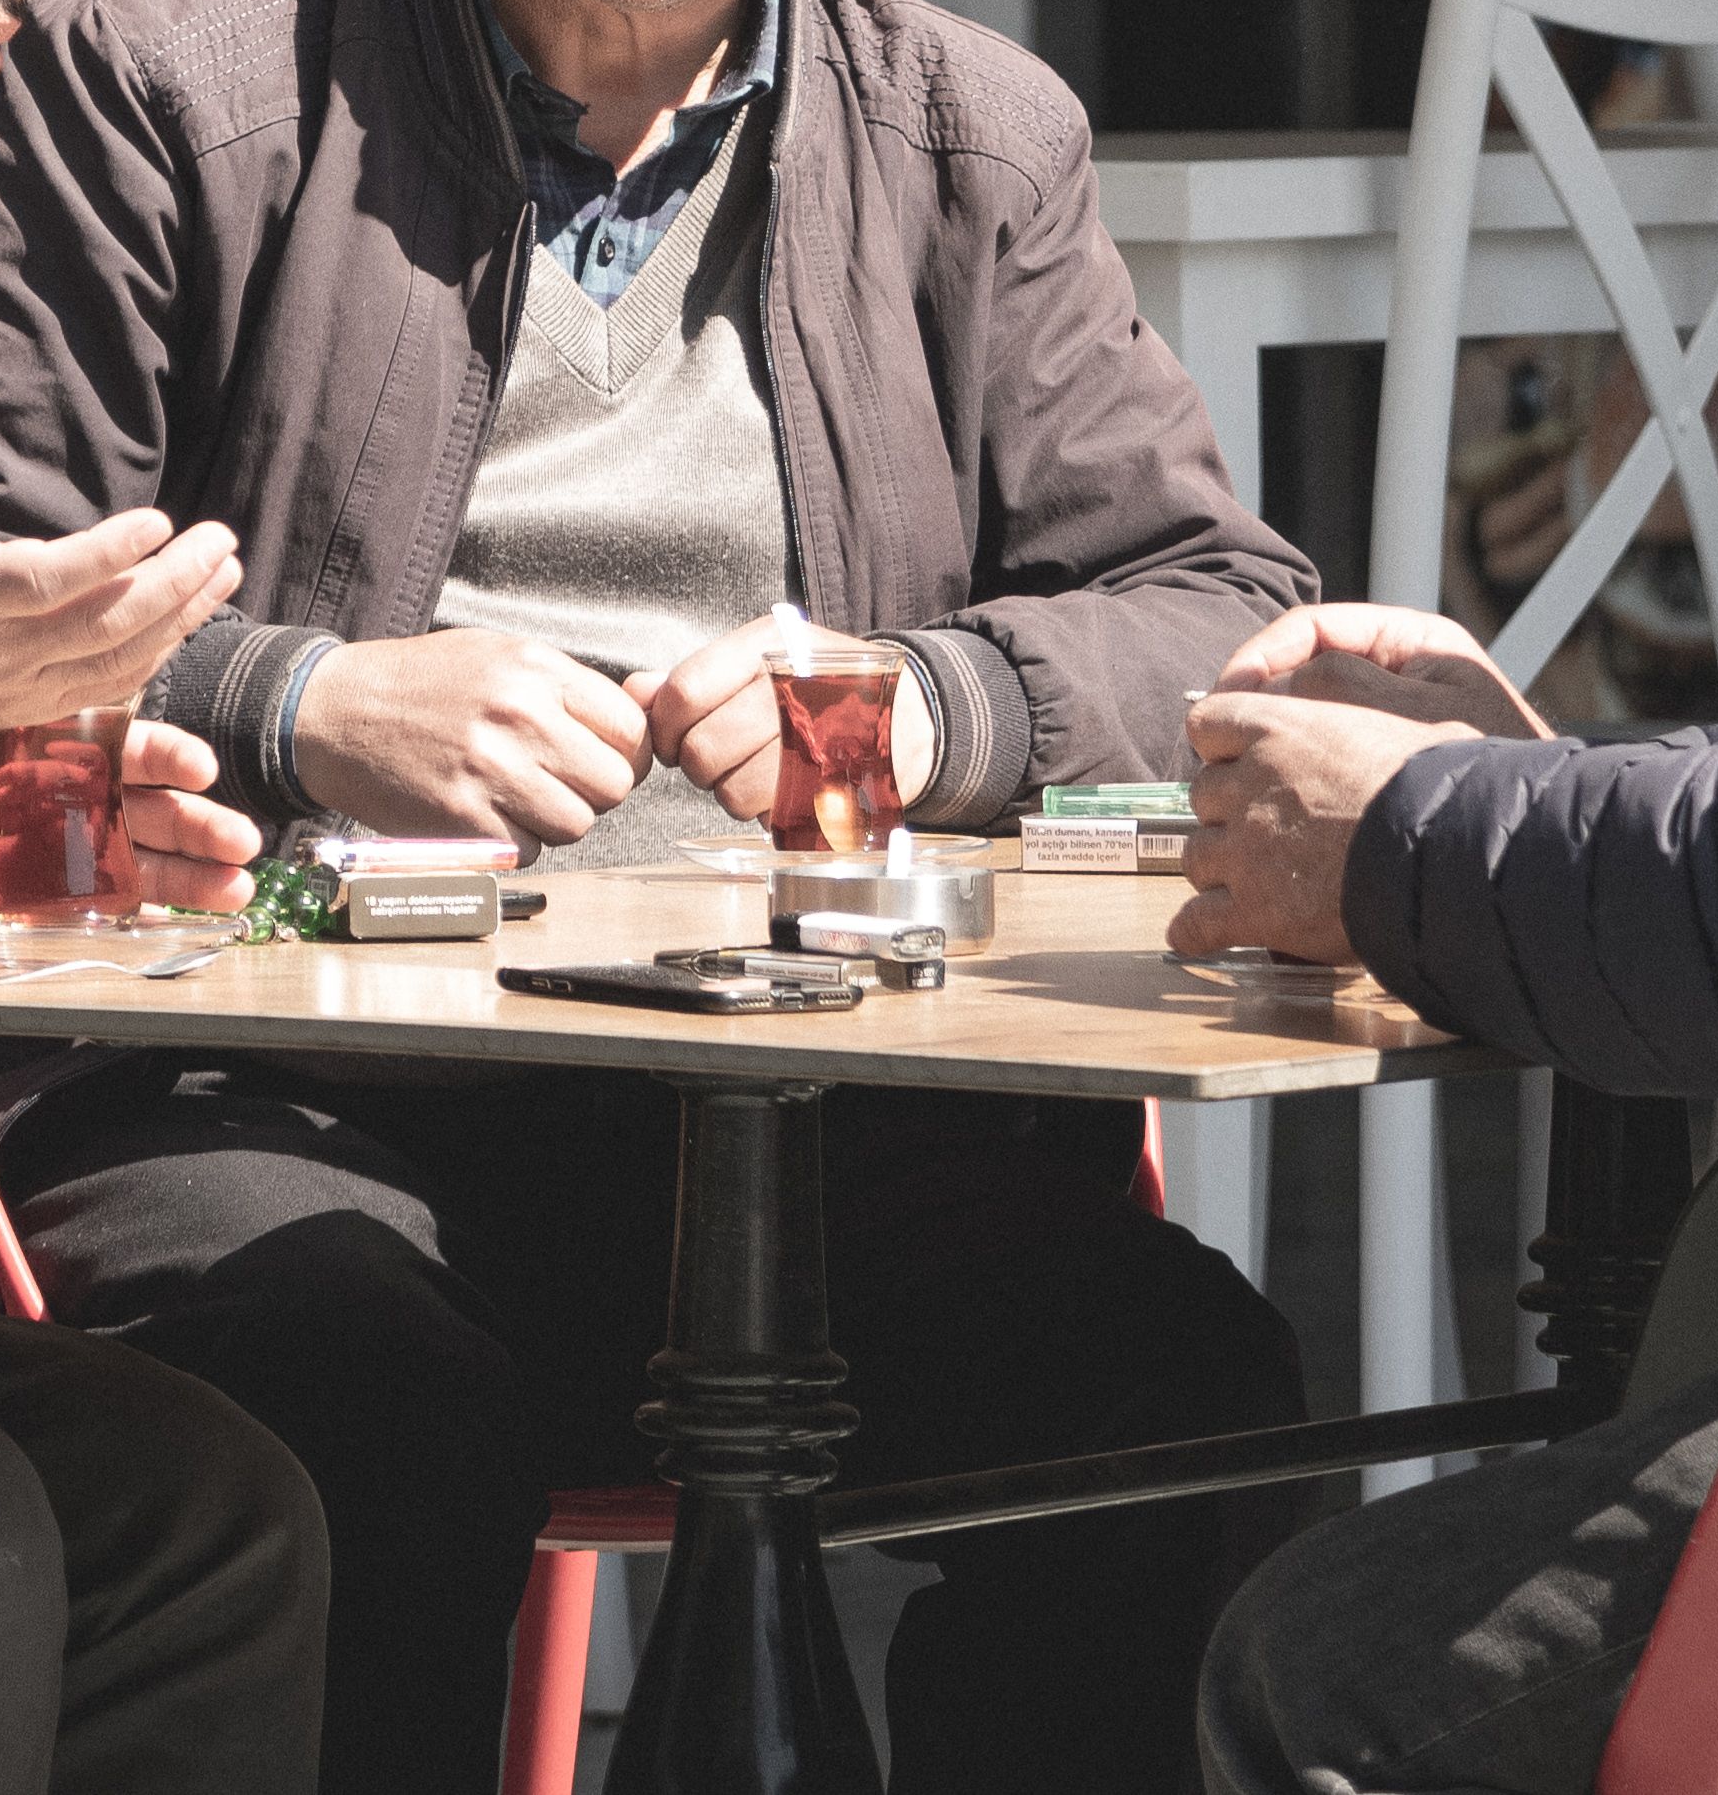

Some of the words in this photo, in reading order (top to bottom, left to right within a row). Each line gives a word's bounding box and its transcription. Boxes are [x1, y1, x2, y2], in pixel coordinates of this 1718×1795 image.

[1095, 827, 1133, 837] kansere
[1025, 840, 1039, 850] yol
[1069, 840, 1102, 849] bilinen
[1037, 852, 1060, 862] fazla
[1061, 852, 1095, 862] madde
[1096, 852, 1121, 864] içerir
